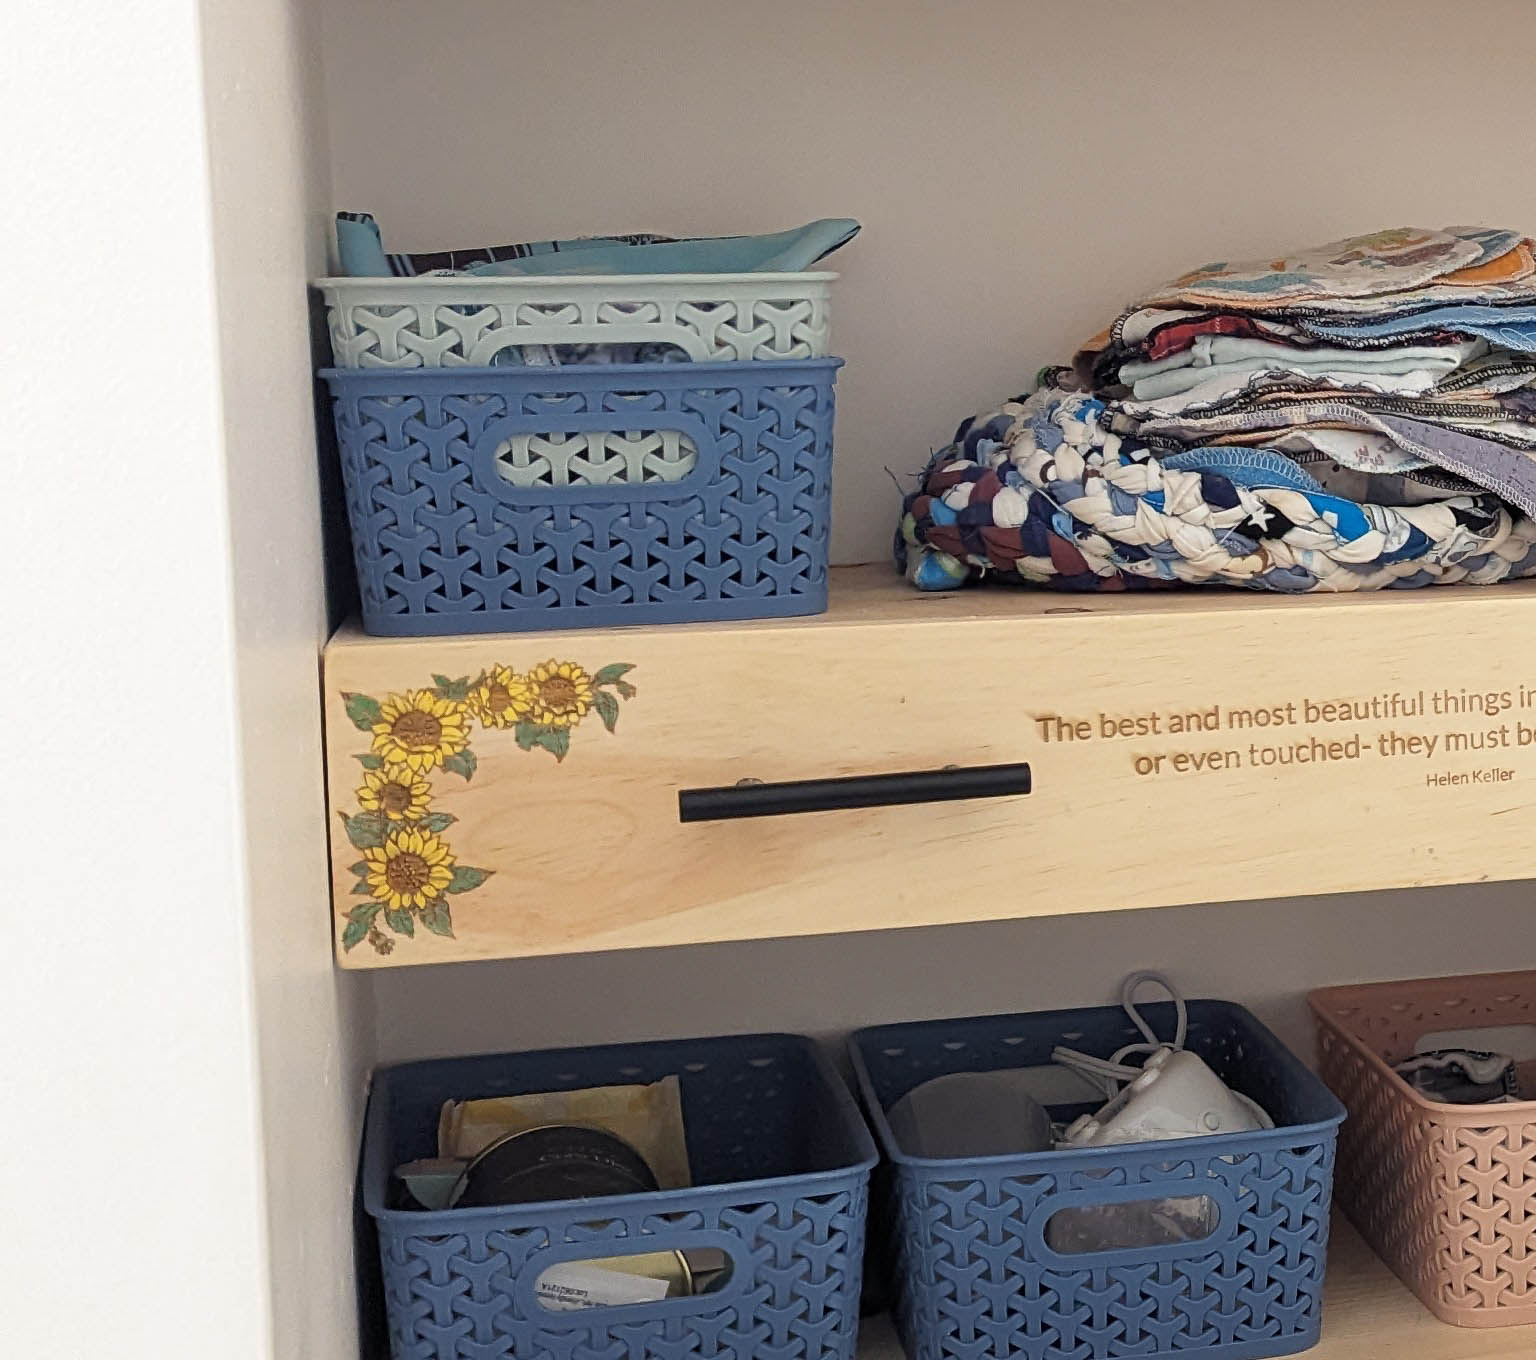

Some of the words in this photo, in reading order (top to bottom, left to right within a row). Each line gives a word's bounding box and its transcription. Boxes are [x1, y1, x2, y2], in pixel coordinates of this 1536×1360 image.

[1034, 715, 1092, 743] The
[1098, 711, 1162, 739] best
[1168, 704, 1220, 733] and
[1227, 701, 1297, 729] most
[1303, 690, 1425, 724] beautiful
[1431, 688, 1512, 717] things
[1134, 753, 1167, 776] or
[1172, 749, 1242, 772] even
[1248, 733, 1372, 766] touched-
[1377, 730, 1439, 758] they
[1444, 724, 1510, 752] must
[1426, 771, 1470, 787] Helen
[1472, 768, 1516, 784] Keller
